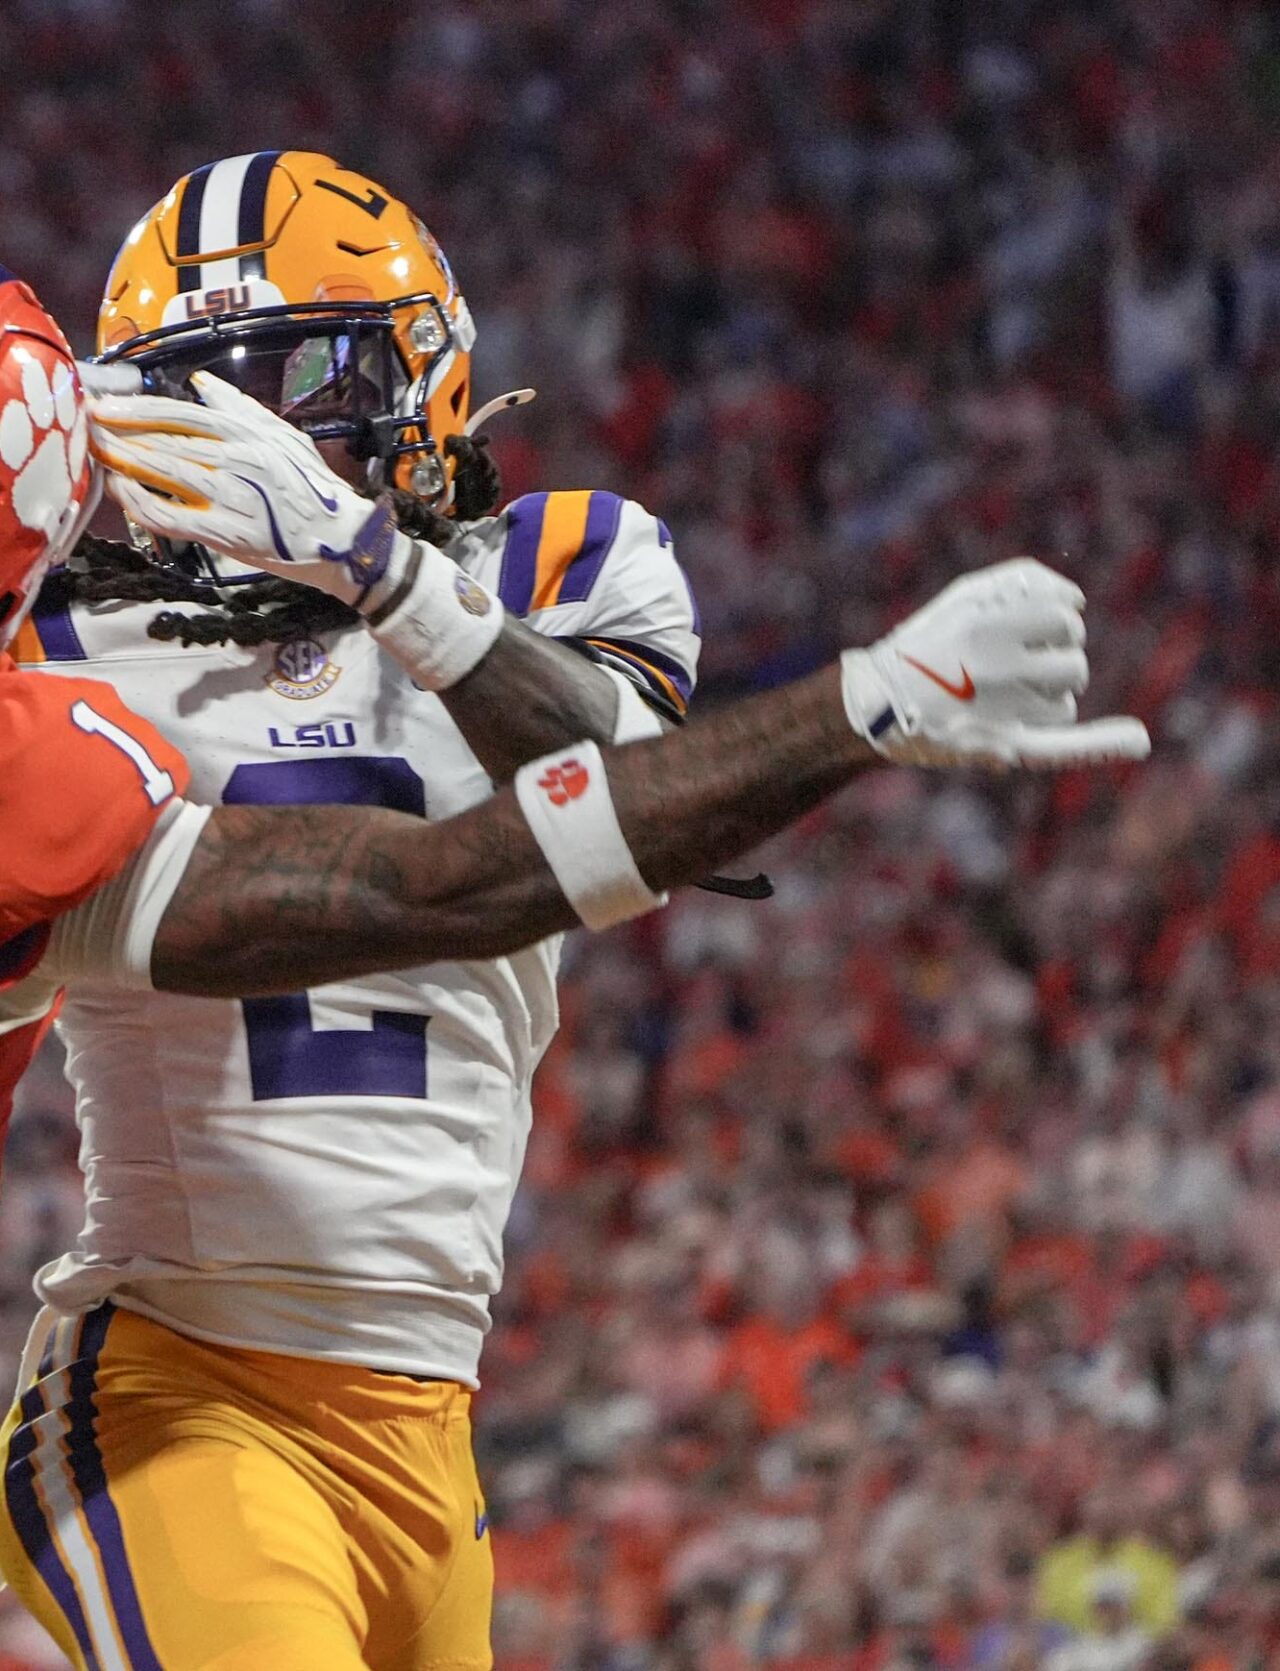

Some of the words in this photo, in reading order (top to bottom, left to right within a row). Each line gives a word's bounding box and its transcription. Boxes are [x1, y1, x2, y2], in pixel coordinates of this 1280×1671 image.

[185, 285, 250, 319] LSU
[267, 722, 356, 748] LSU
[70, 698, 176, 807] 1
